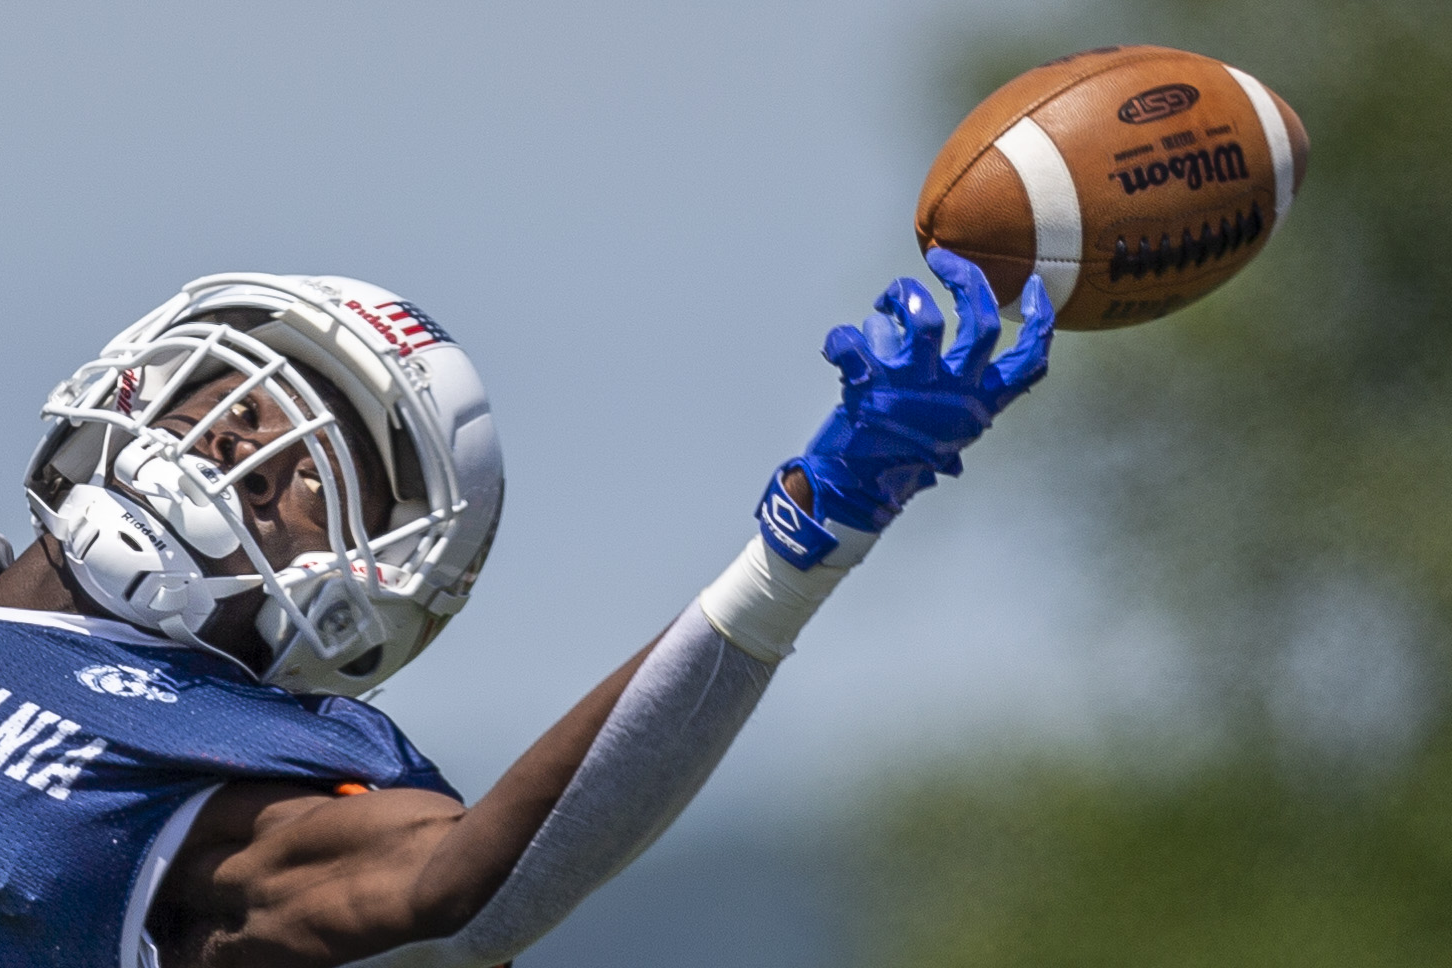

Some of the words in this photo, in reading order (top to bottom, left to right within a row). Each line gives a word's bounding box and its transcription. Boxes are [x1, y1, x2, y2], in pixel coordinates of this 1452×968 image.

[1128, 87, 1191, 123] GST
[1115, 141, 1250, 195] Wilson
[344, 299, 413, 358] Riddell
[116, 367, 139, 417] ddell
[121, 511, 167, 551] Riddell
